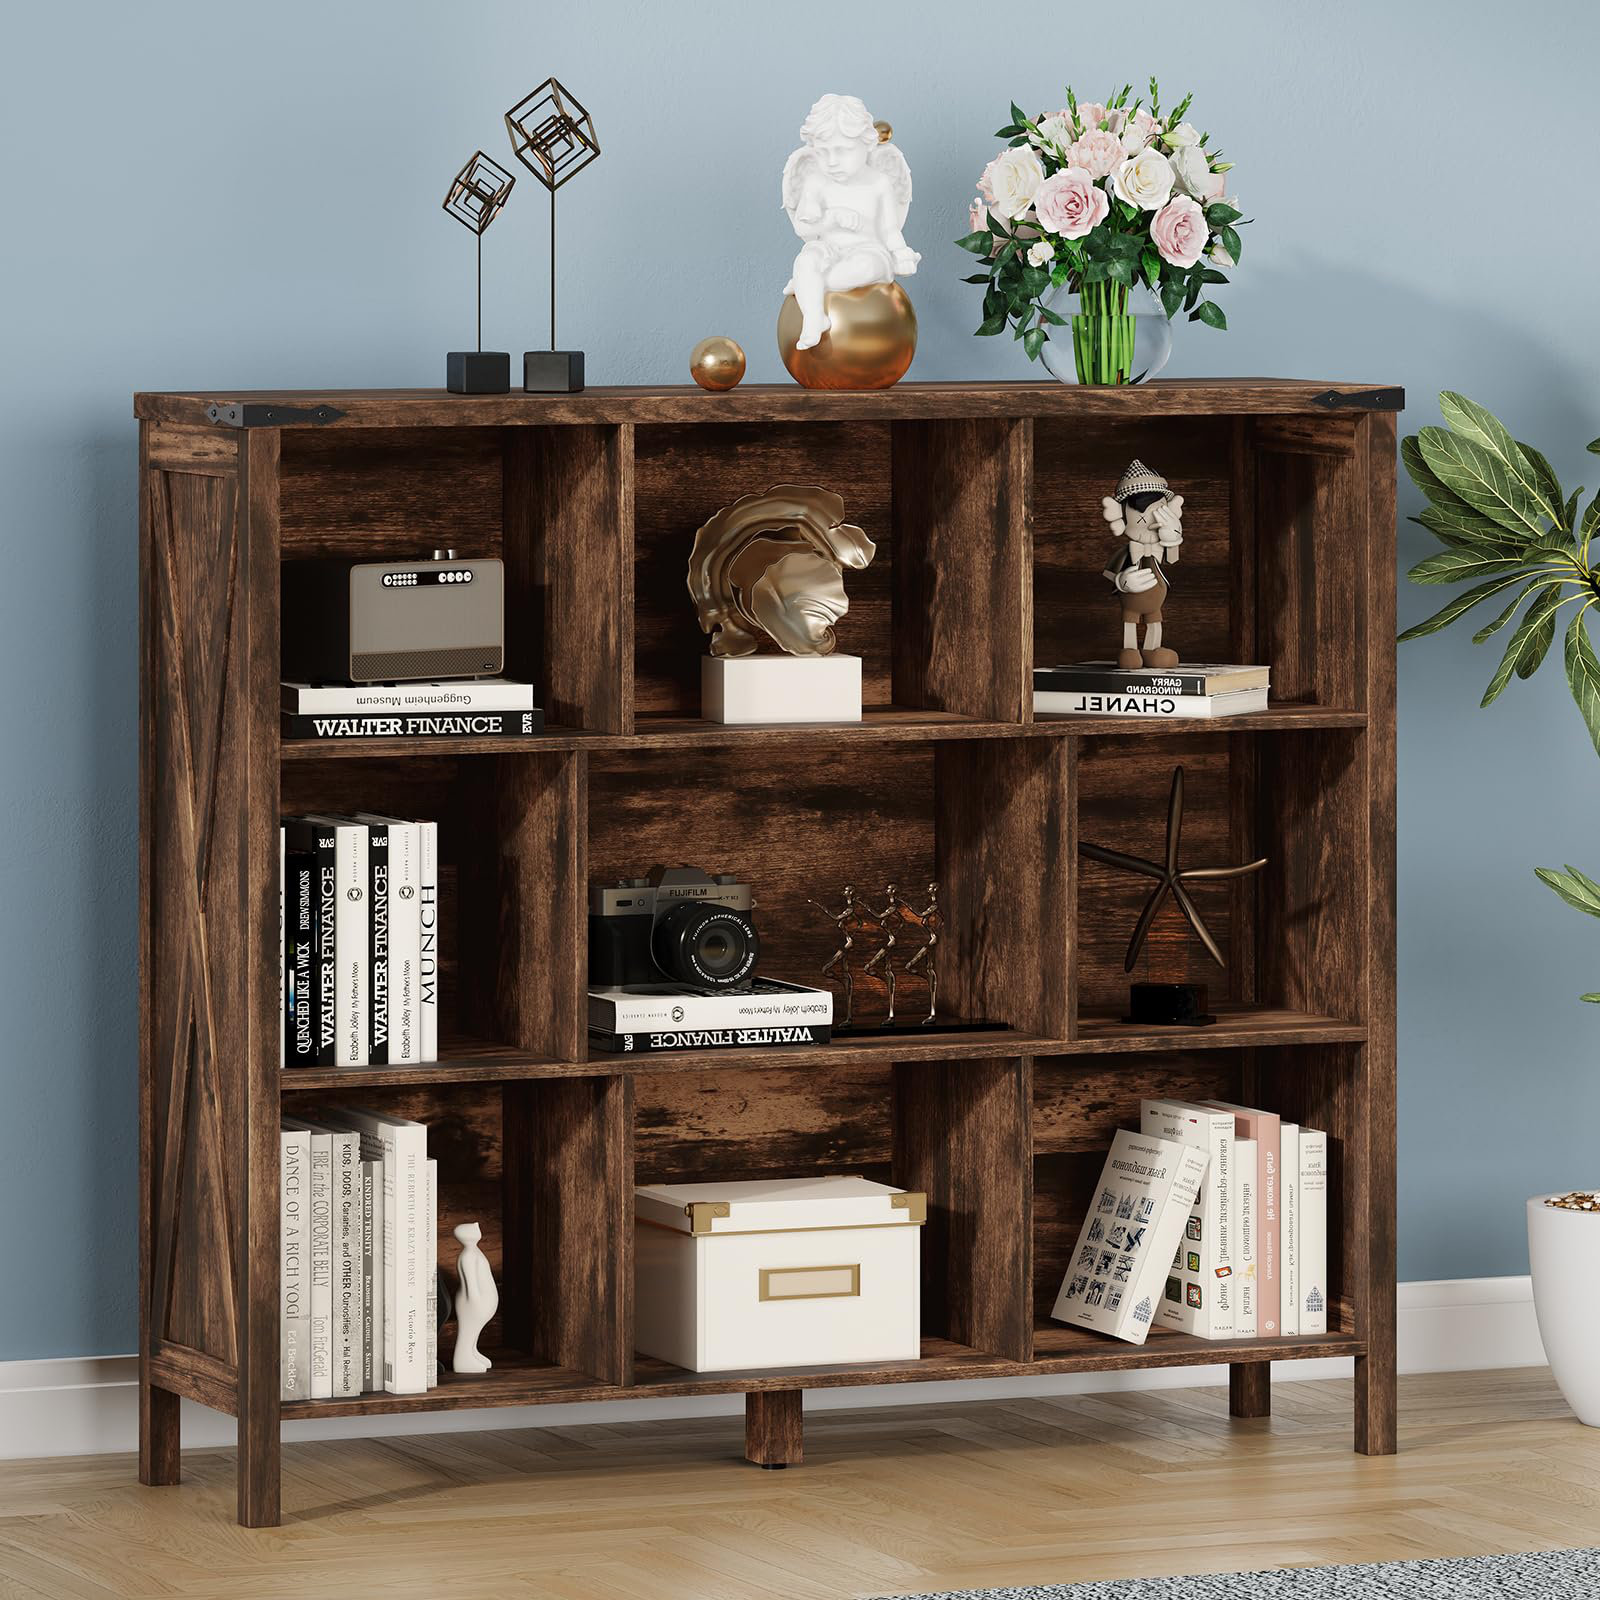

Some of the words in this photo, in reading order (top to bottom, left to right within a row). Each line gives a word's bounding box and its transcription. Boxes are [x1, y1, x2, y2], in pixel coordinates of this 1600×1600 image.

[357, 696, 401, 705] Museum
[404, 695, 471, 705] Guggenheim
[313, 718, 403, 736] WALTER
[406, 716, 502, 734] FINANCE
[522, 713, 532, 734] EVR
[319, 838, 335, 848] EVR
[372, 837, 388, 846] EVR
[300, 870, 310, 906] SIMMONS
[670, 889, 707, 897] FUJIFILM
[300, 906, 310, 929] DREW
[321, 867, 335, 959] FINANCE
[375, 865, 388, 957] FINANCE
[297, 942, 310, 968] WICK
[421, 885, 435, 1004] MUNCH
[297, 979, 310, 999] LIKE
[321, 961, 335, 1048] WALTER
[375, 959, 388, 1046] WALTER
[783, 1005, 800, 1014] Jolley
[801, 1004, 827, 1014] Elizabeth
[297, 1001, 312, 1053] QUENCHED
[350, 1011, 360, 1030] Jolley
[402, 1008, 412, 1028] Jolley
[350, 1031, 359, 1060] Elizabeth
[401, 1029, 410, 1058] Elizabeth
[624, 1034, 633, 1052] EVR
[650, 1030, 733, 1047] FINANCE
[736, 1027, 813, 1044] WALTER
[312, 1151, 329, 1169] FIRE
[341, 1144, 351, 1168] KIDS,
[286, 1145, 300, 1196] DANCE
[312, 1172, 328, 1181] in
[312, 1183, 329, 1198] the
[341, 1171, 351, 1199] DOGS,
[364, 1177, 372, 1218] KINDRED
[286, 1201, 300, 1220] OF
[341, 1201, 351, 1239] Canaries,
[286, 1227, 300, 1237] A
[312, 1200, 329, 1257] CORPORATE
[364, 1219, 372, 1256] TRINITY
[286, 1243, 300, 1277] RICH
[342, 1243, 351, 1257] and
[312, 1260, 329, 1287] BELLY
[342, 1260, 352, 1289] OTHER
[286, 1283, 300, 1319] YOGI
[313, 1314, 328, 1333] Tom
[342, 1292, 352, 1335] Curiosities
[407, 1309, 416, 1340] Victorio
[287, 1330, 297, 1344] Ed
[312, 1336, 328, 1377] FitzGerald
[405, 1342, 416, 1363] Reyes
[285, 1348, 297, 1391] Beckley
